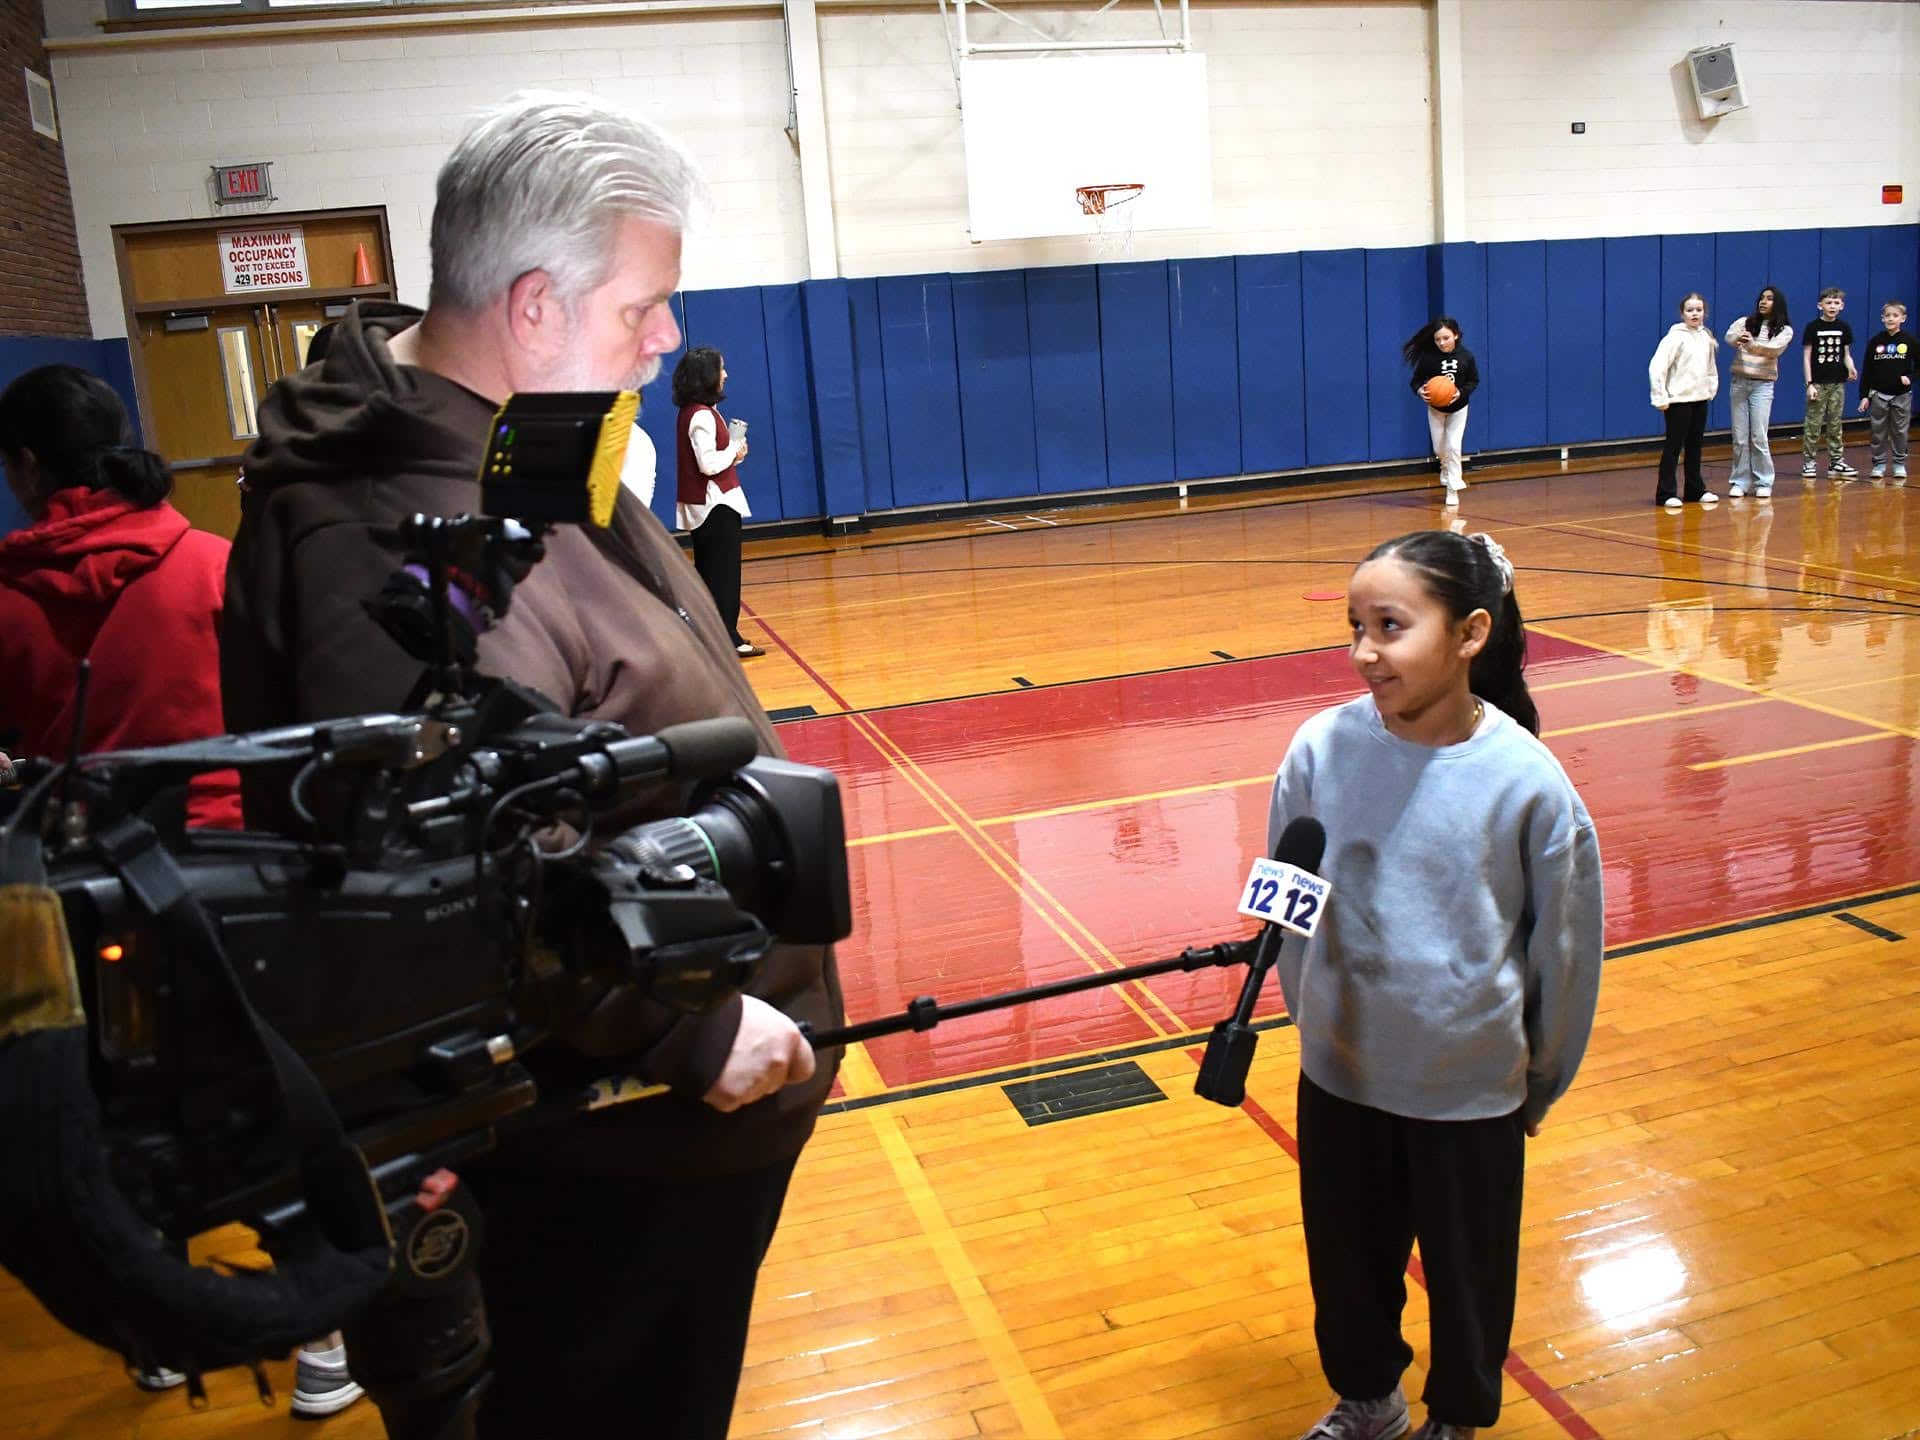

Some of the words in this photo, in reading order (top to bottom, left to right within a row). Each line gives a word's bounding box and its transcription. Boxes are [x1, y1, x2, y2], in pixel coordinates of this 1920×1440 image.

[228, 168, 259, 194] EXIT
[231, 233, 292, 248] MAXIMUM
[229, 247, 297, 263] OCCUPANCY
[234, 264, 250, 273] NOT
[253, 263, 263, 271] TO
[265, 260, 296, 271] EXCEED
[235, 274, 251, 285] 429
[253, 271, 303, 286] PERSONS
[1258, 864, 1285, 879] news
[1291, 873, 1325, 896] news
[1247, 878, 1279, 914] 12
[425, 897, 478, 922] SONY
[1283, 888, 1318, 931] 12
